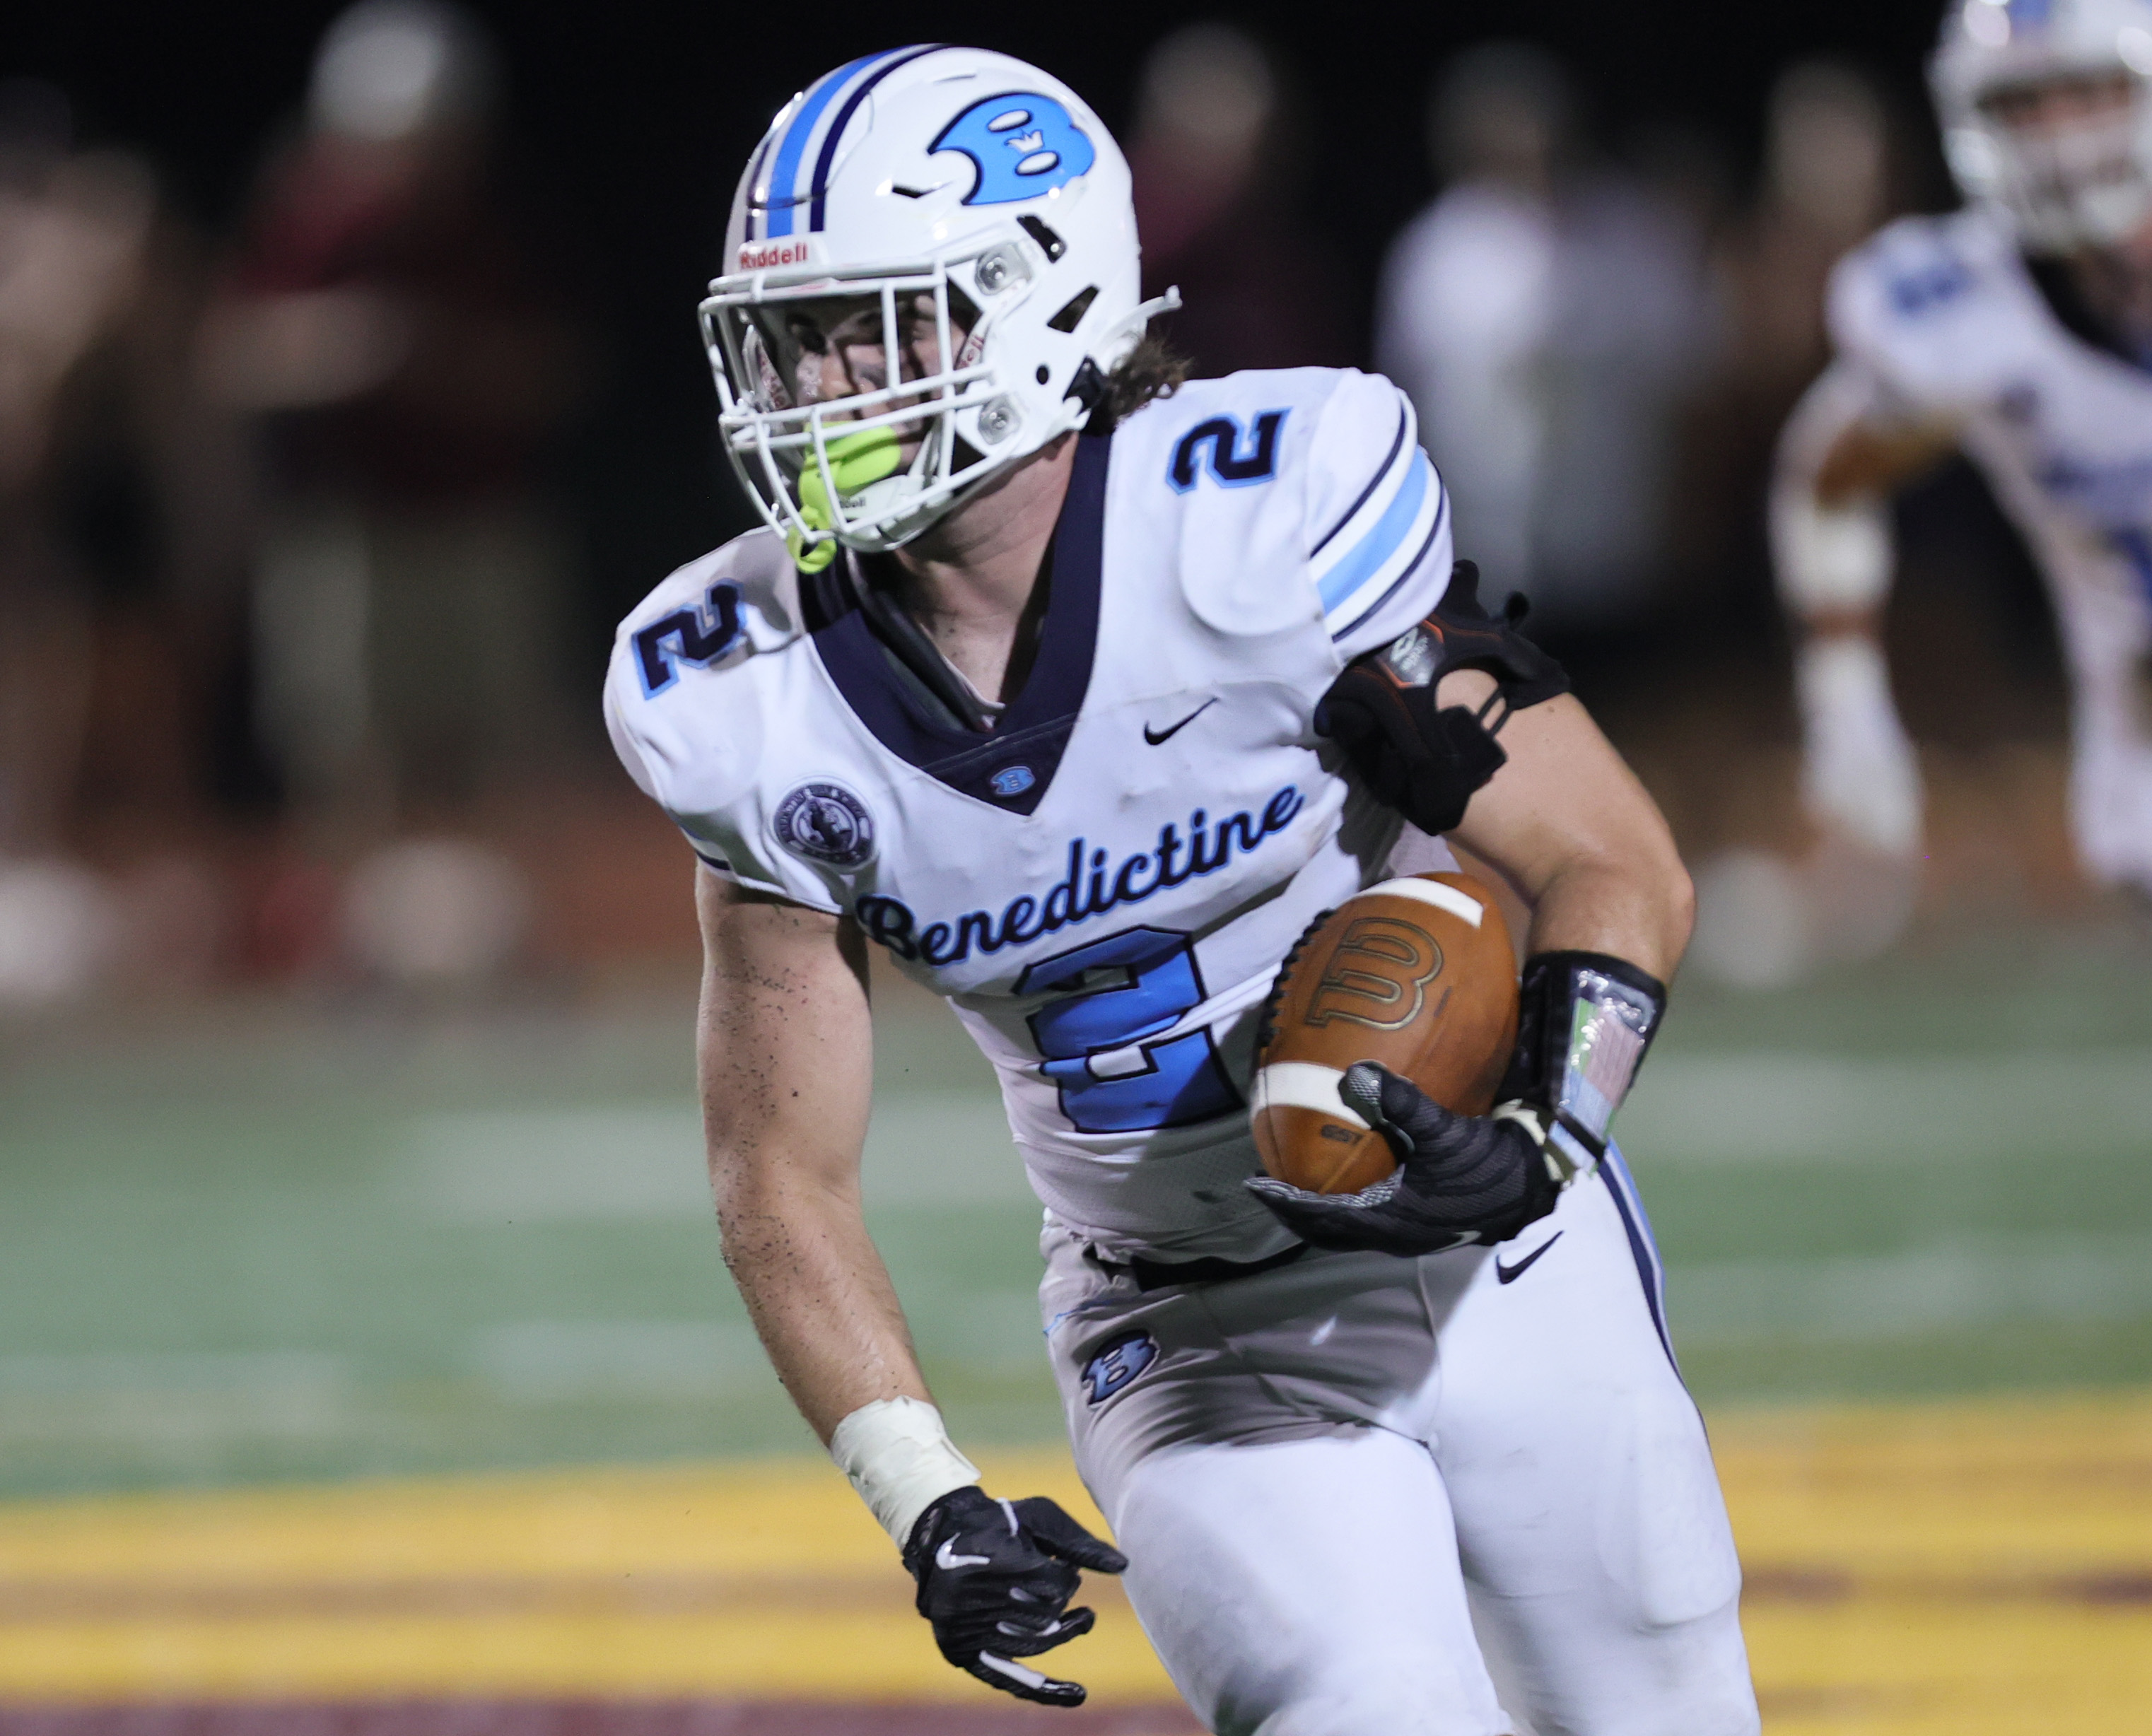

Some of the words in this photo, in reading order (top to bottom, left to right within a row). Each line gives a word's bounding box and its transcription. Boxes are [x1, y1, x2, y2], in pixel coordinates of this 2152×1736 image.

[925, 89, 1097, 206] B
[740, 244, 807, 269] Riddell
[1166, 406, 1292, 495] 2
[631, 577, 747, 700] 2
[856, 785, 1305, 966] Benedictine
[1011, 924, 1246, 1134] 2
[1081, 1330, 1158, 1406] B
